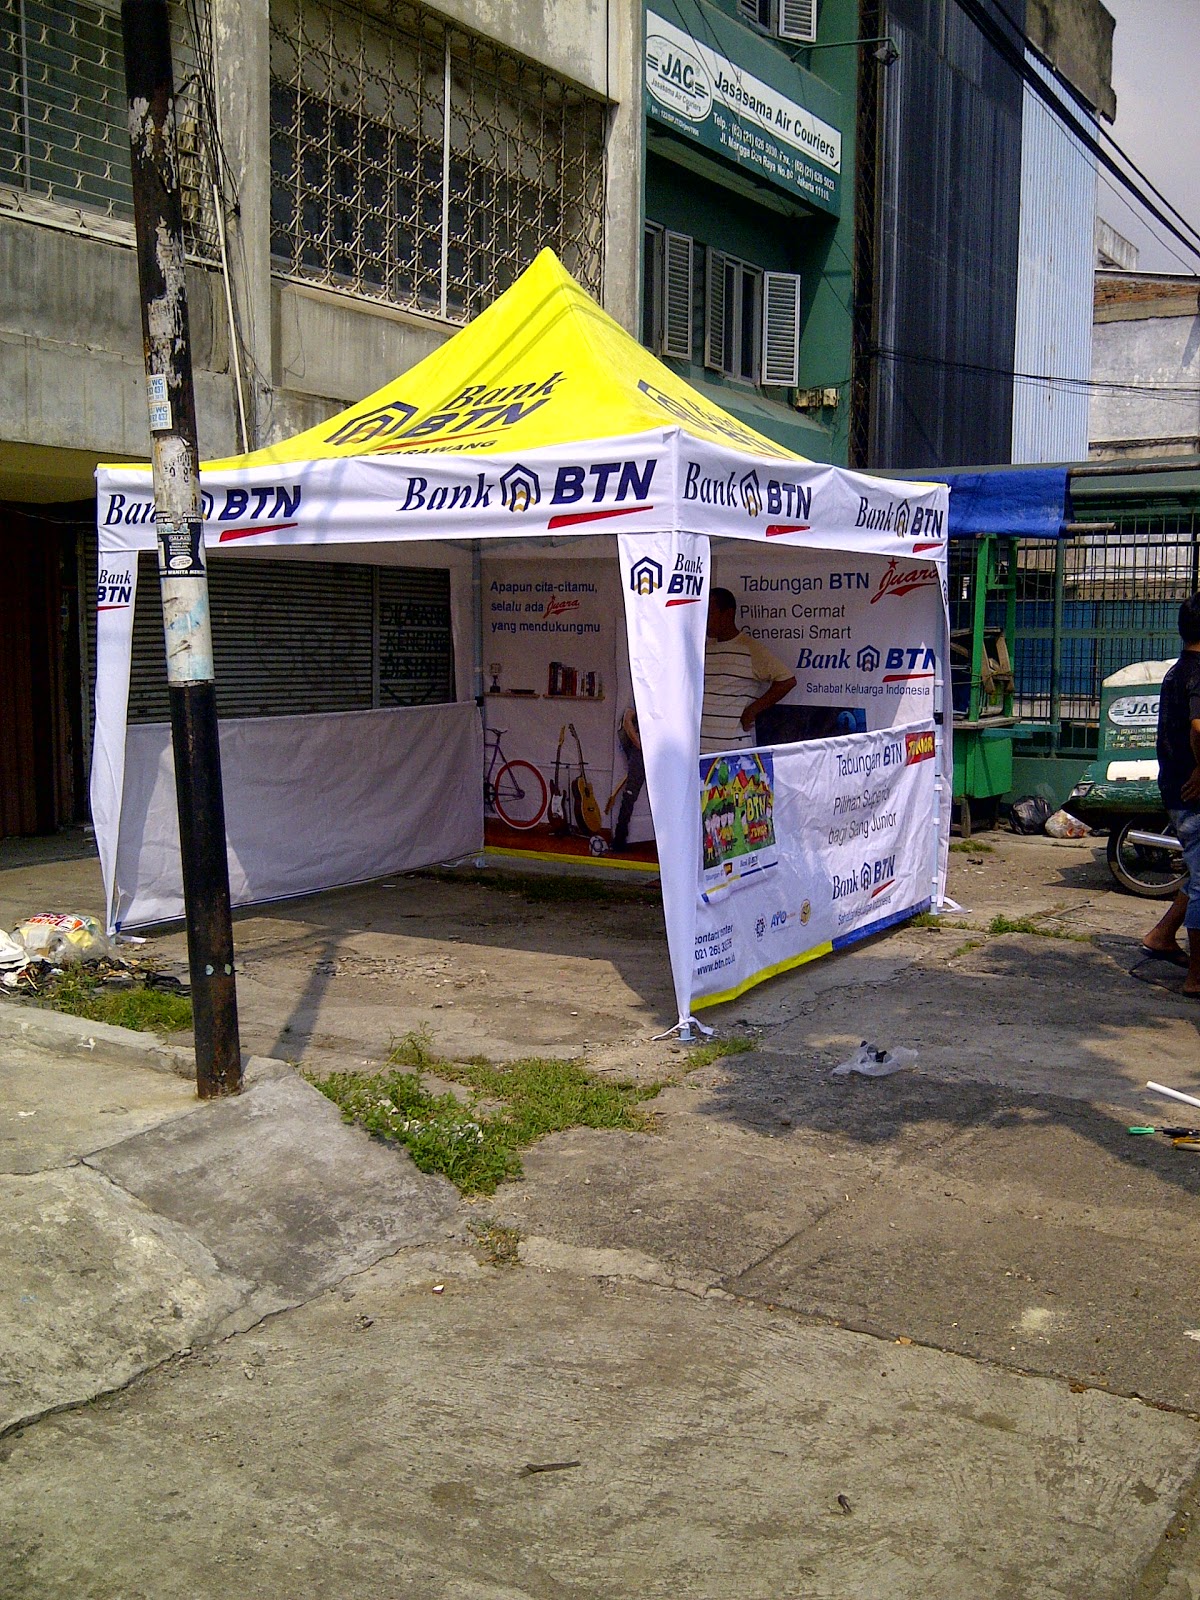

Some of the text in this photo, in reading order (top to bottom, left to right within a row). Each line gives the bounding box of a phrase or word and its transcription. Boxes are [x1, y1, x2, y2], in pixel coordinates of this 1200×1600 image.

[662, 53, 694, 89] JAC
[714, 71, 772, 121] Jasasama
[775, 109, 791, 131] Air
[794, 120, 835, 159] Couriers
[434, 371, 567, 412] Bank
[394, 398, 552, 439] BTN
[397, 459, 658, 512] Bank BTN
[682, 461, 812, 520] Bank BTN
[103, 485, 301, 526] Ban BTN
[855, 496, 944, 538] Bank BTN
[673, 553, 704, 574] Bank
[98, 569, 132, 584] Bank
[490, 581, 532, 594] Apapun
[667, 573, 704, 596] BTN
[740, 575, 823, 595] Tabungan
[829, 573, 869, 590] BTN
[97, 586, 132, 603] BTN
[491, 601, 522, 612] selalu
[525, 602, 544, 612] ada
[740, 604, 845, 619] Pilihan Cermat
[491, 621, 600, 635] yang mendukungmu
[809, 625, 852, 640] Smart
[796, 648, 851, 670] Bank
[806, 682, 930, 696] Sahabat Keluarga Indonesia
[883, 743, 902, 767] BTN
[849, 819, 869, 838] Sang
[871, 810, 896, 832] Junior
[832, 855, 895, 900] Bank BTN
